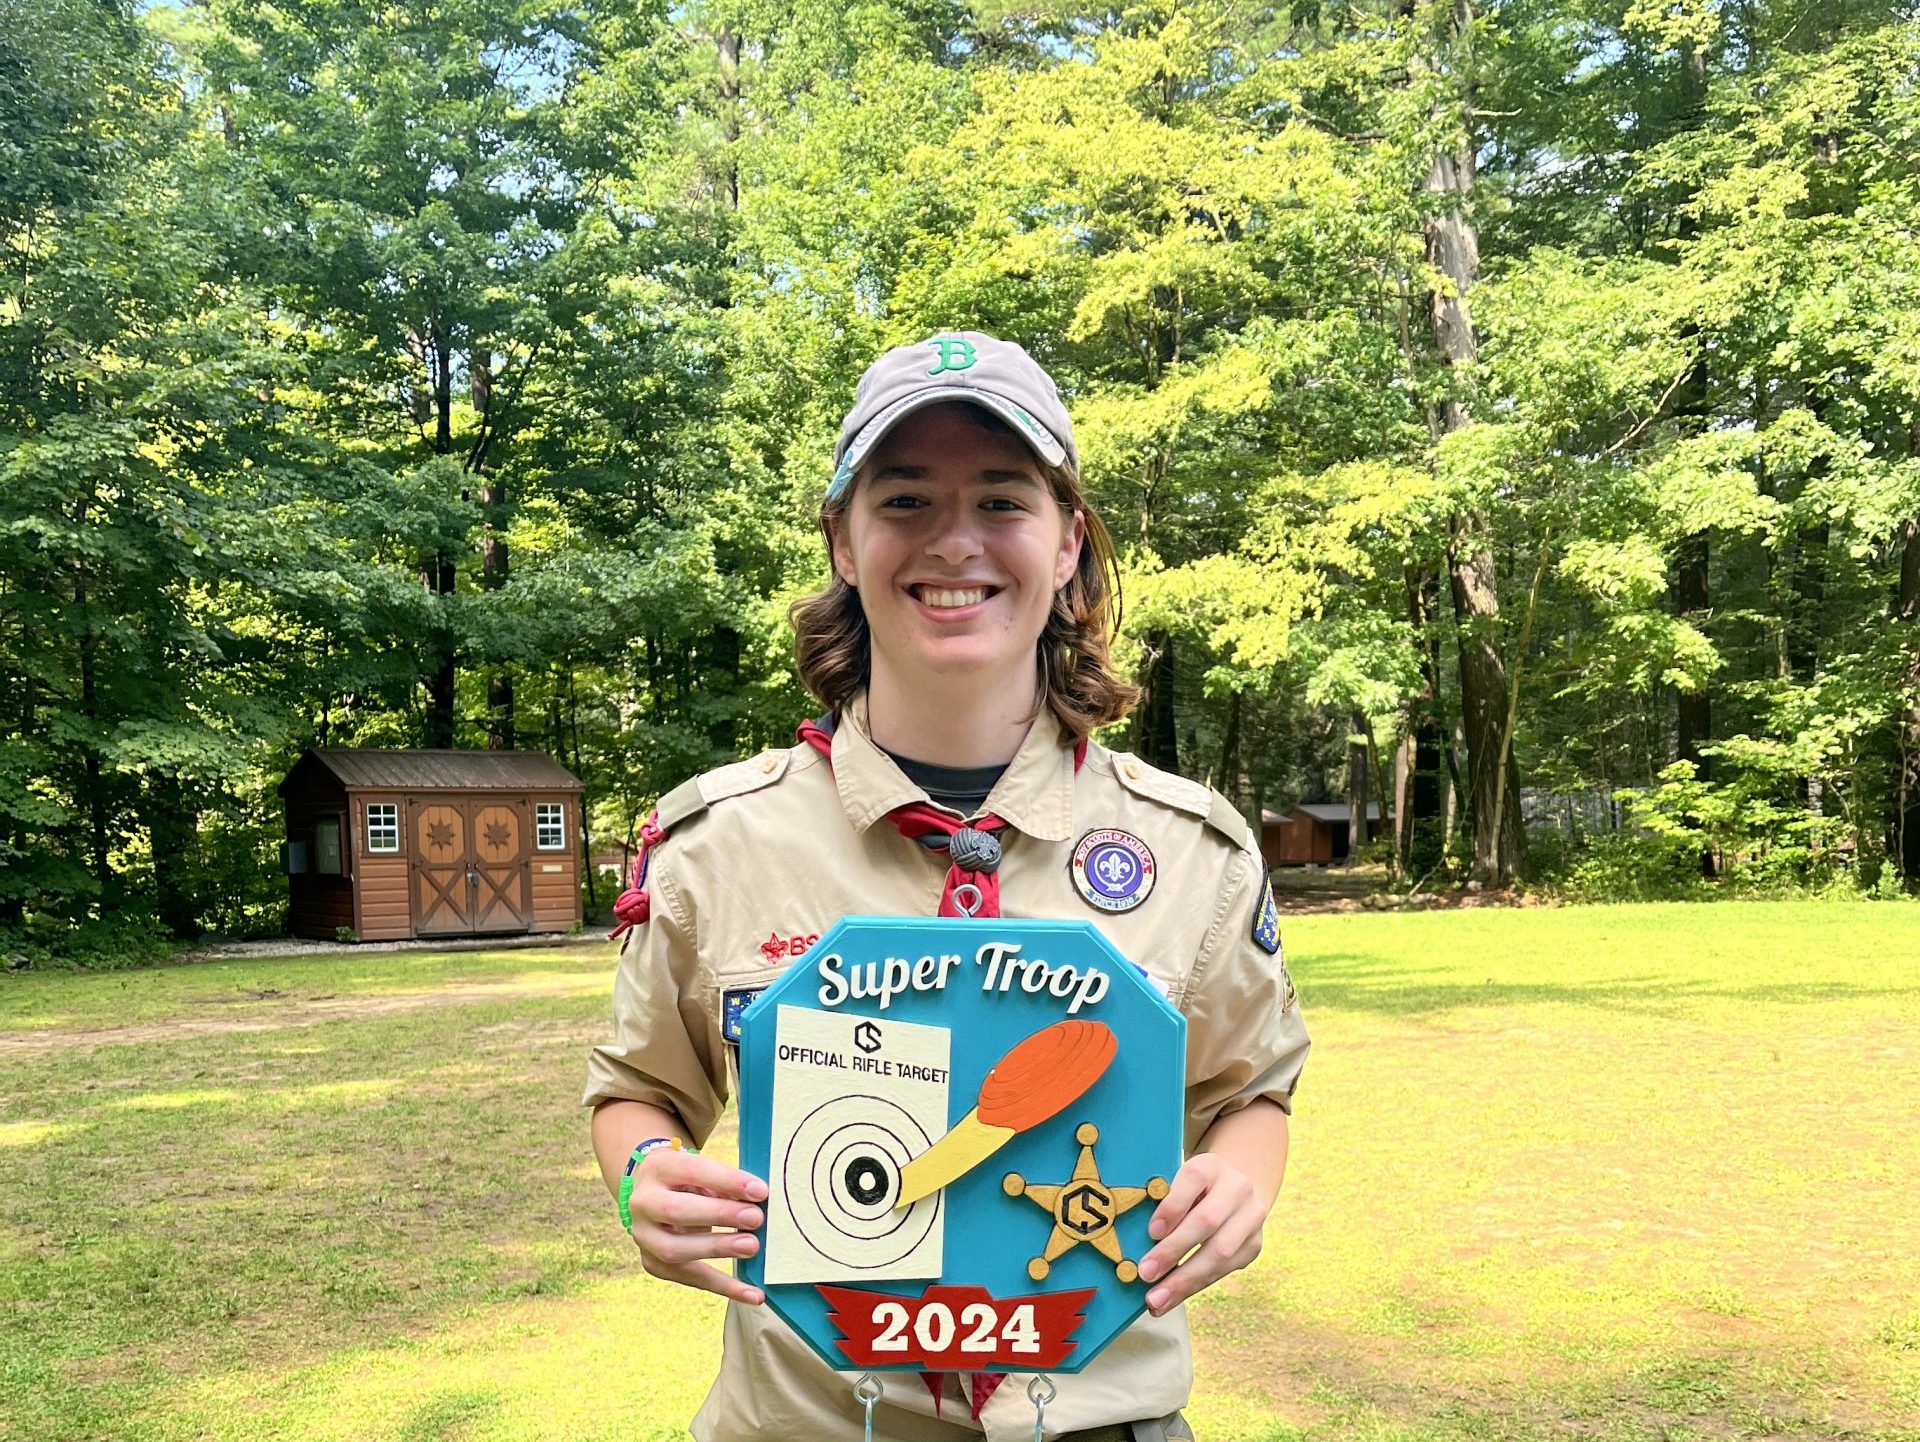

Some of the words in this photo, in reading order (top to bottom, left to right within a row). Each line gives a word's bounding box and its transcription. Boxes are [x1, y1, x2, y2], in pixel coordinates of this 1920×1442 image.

[928, 338, 978, 375] B
[818, 953, 961, 1010] Super
[975, 941, 1110, 1014] Troop
[778, 1044, 848, 1069] OFFICIAL
[852, 1056, 892, 1076] RIFLE
[896, 1063, 948, 1084] TARGET
[871, 1302, 1040, 1353] 2024
